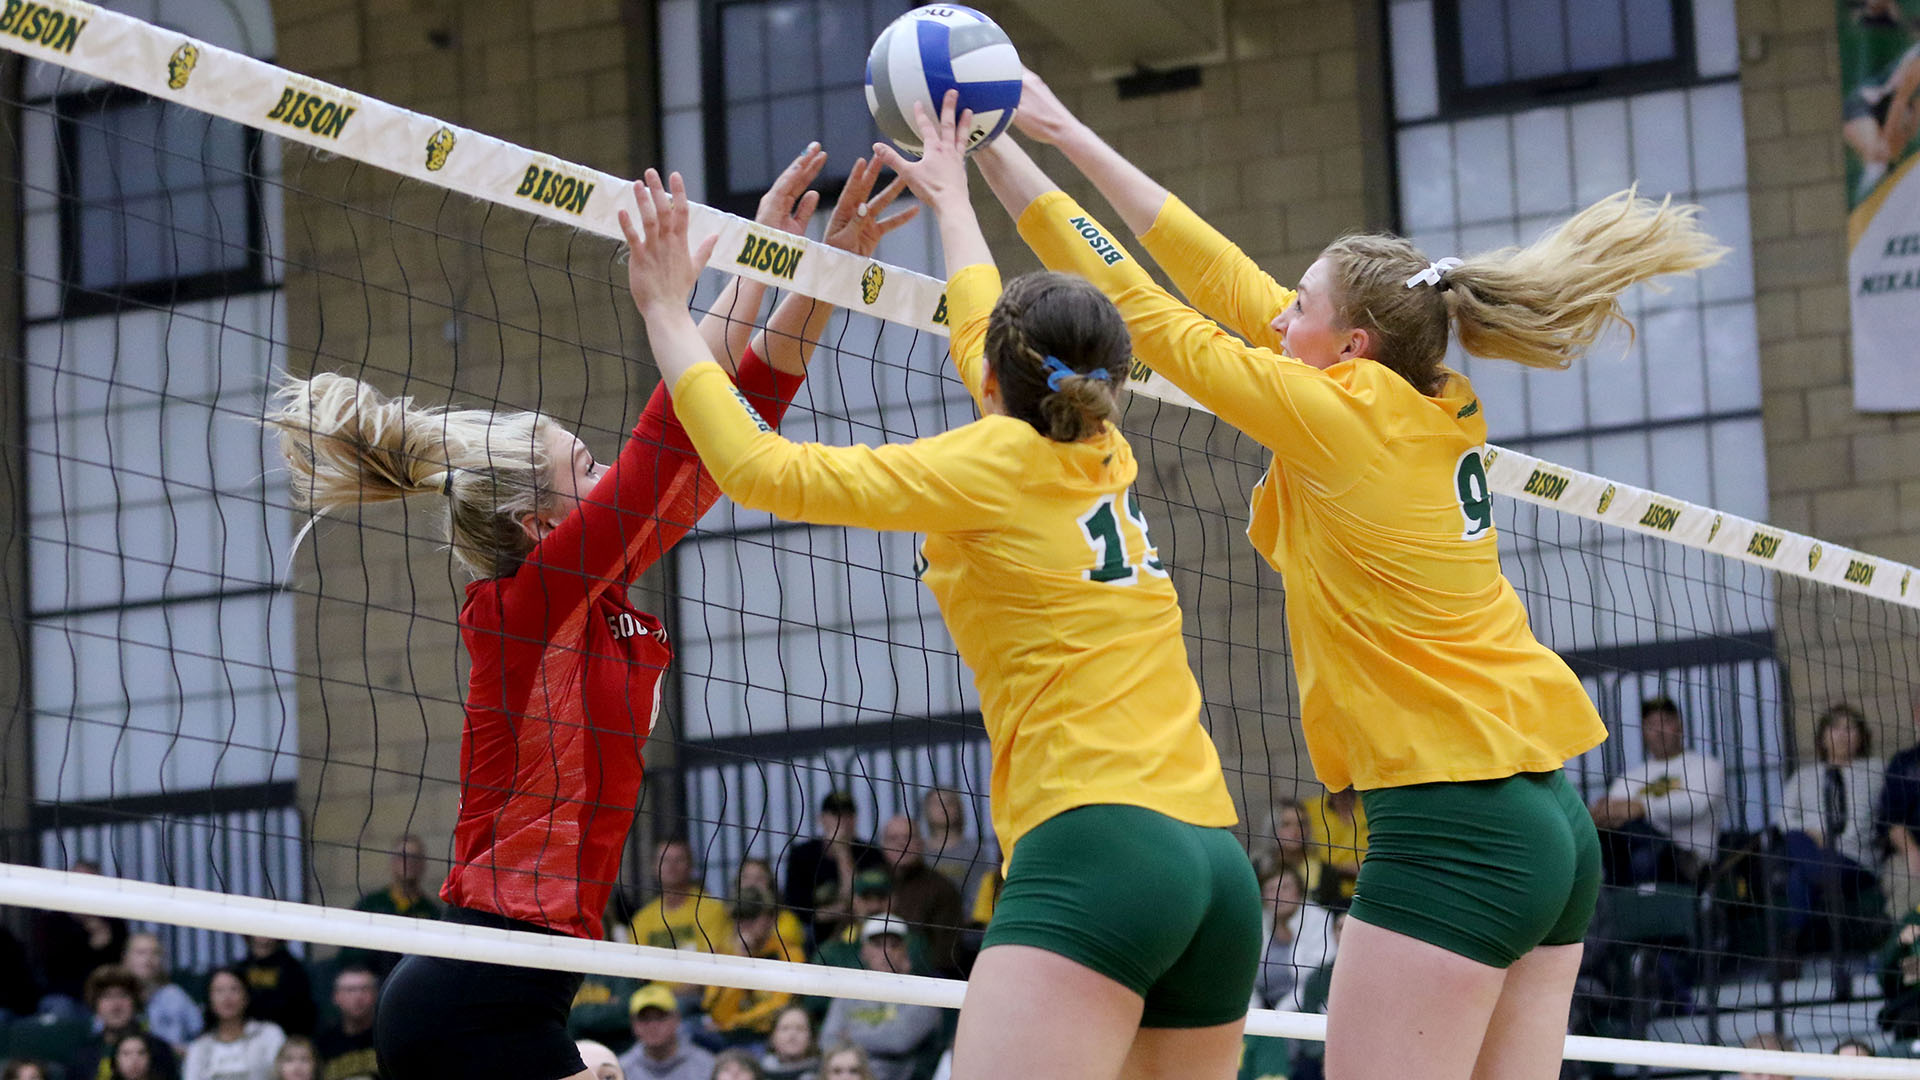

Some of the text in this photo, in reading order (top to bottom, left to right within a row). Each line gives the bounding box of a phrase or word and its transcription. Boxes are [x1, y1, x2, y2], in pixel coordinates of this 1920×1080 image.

[0, 0, 87, 53] BISON
[267, 86, 355, 140] BISON
[515, 163, 595, 215] BISON
[736, 232, 804, 281] BISON
[1068, 216, 1125, 267] BISON
[1453, 446, 1494, 540] 9
[1523, 469, 1569, 502] BISON
